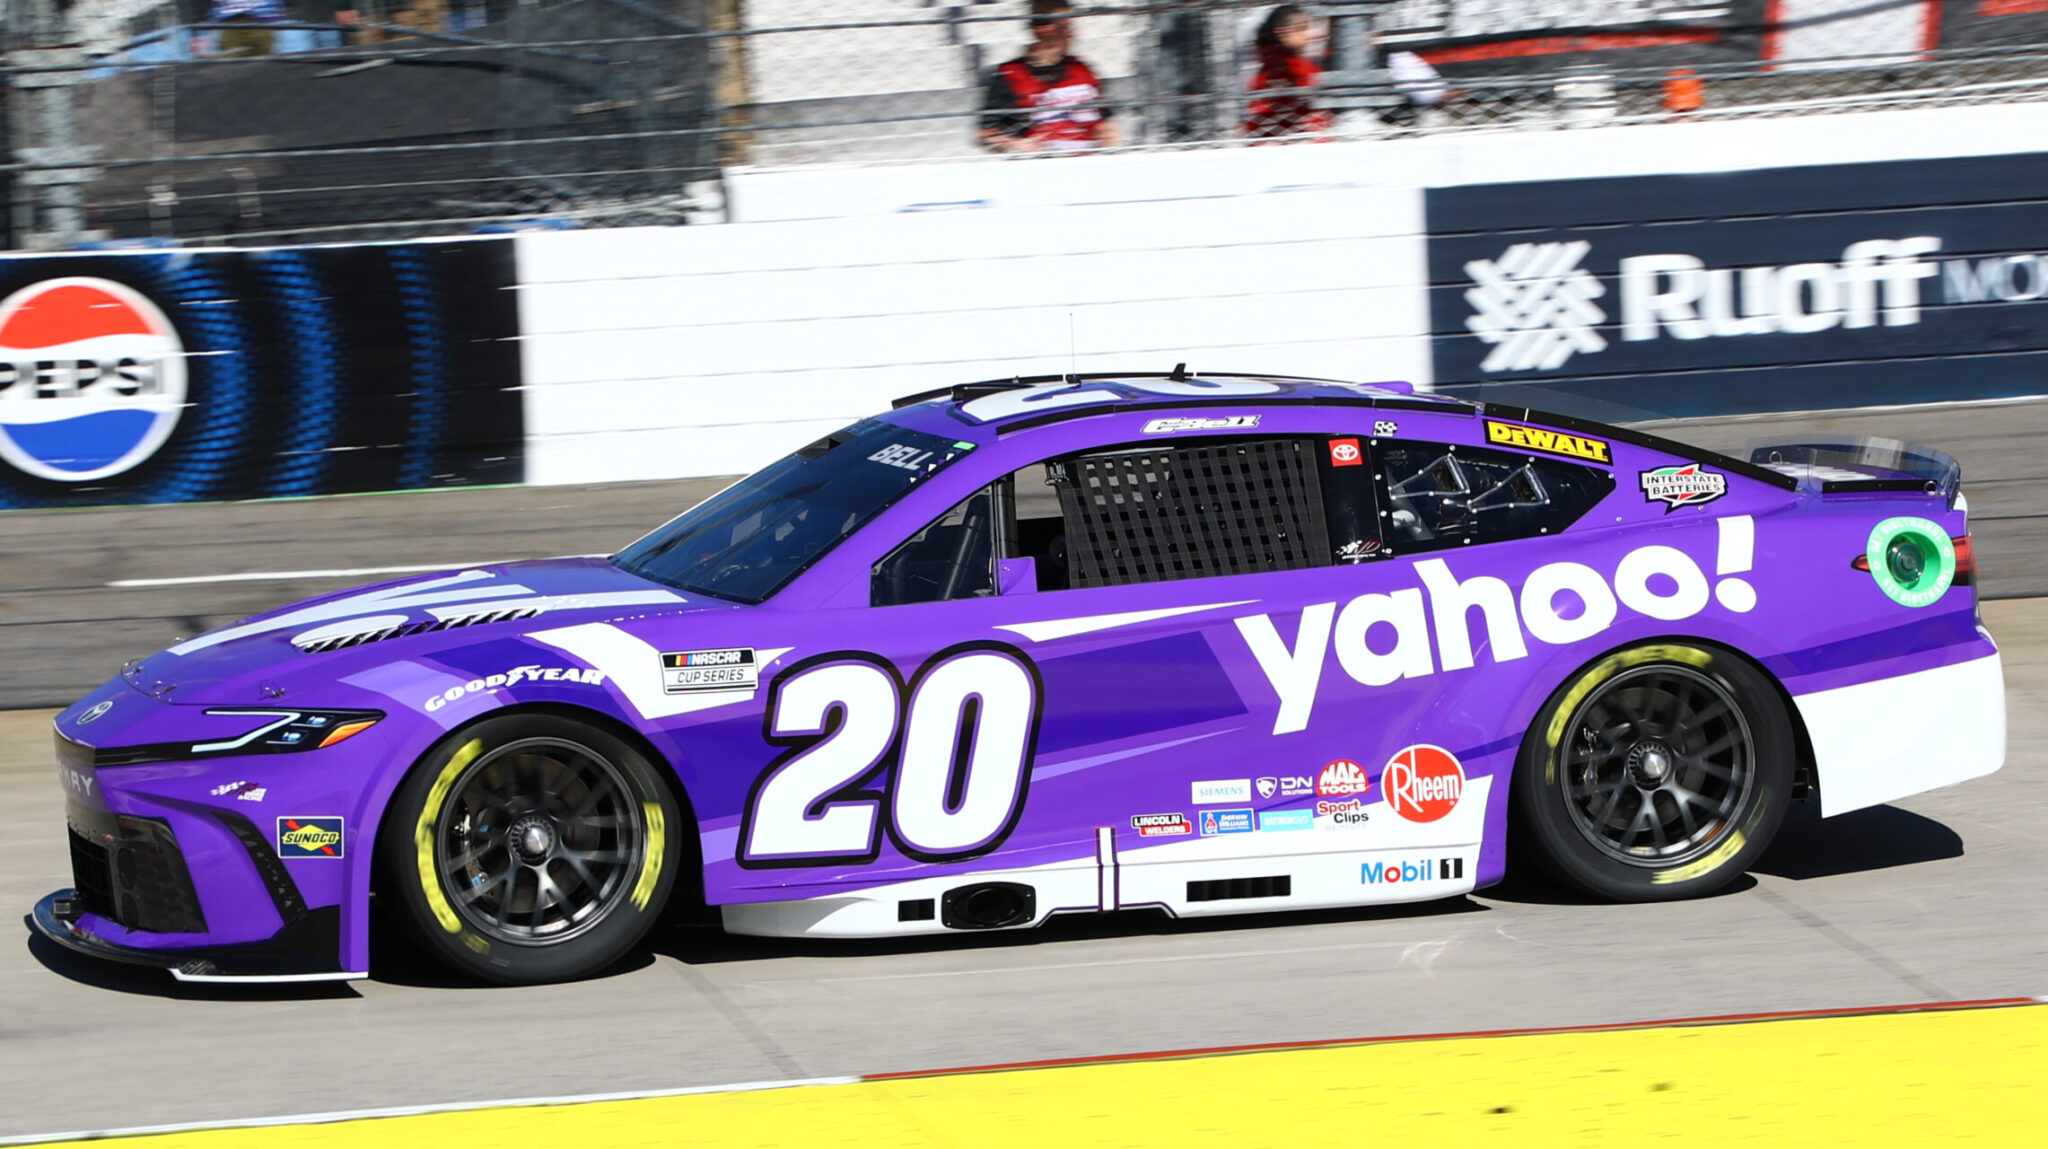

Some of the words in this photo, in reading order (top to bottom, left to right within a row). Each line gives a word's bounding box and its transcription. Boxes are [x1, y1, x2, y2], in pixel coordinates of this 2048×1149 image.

[1620, 236, 1942, 341] Ruoff
[1488, 421, 1609, 461] DEWALT
[867, 443, 934, 471] BELL
[1646, 475, 1721, 484] INTERSTATE
[1652, 484, 1720, 495] BATTERIES
[1233, 515, 1757, 736] yahoo!
[691, 651, 742, 666] NASCAR
[677, 671, 701, 684] CUP
[703, 668, 744, 682] SERIES
[424, 665, 603, 712] GOODYEAR
[741, 645, 1039, 863] 20
[1319, 761, 1366, 786] MAC
[1391, 749, 1460, 813] Rheem
[1280, 776, 1314, 789] DN
[1320, 782, 1367, 795] TOOLS
[1199, 785, 1245, 797] SIEMENS
[1318, 800, 1360, 815] Sport
[1134, 815, 1181, 826] LINCOLN
[1333, 812, 1369, 824] Clips
[1144, 825, 1187, 835] WELDERS
[285, 833, 338, 844] SUNOCO
[1361, 859, 1432, 885] Mobil
[1443, 858, 1460, 879] 1
